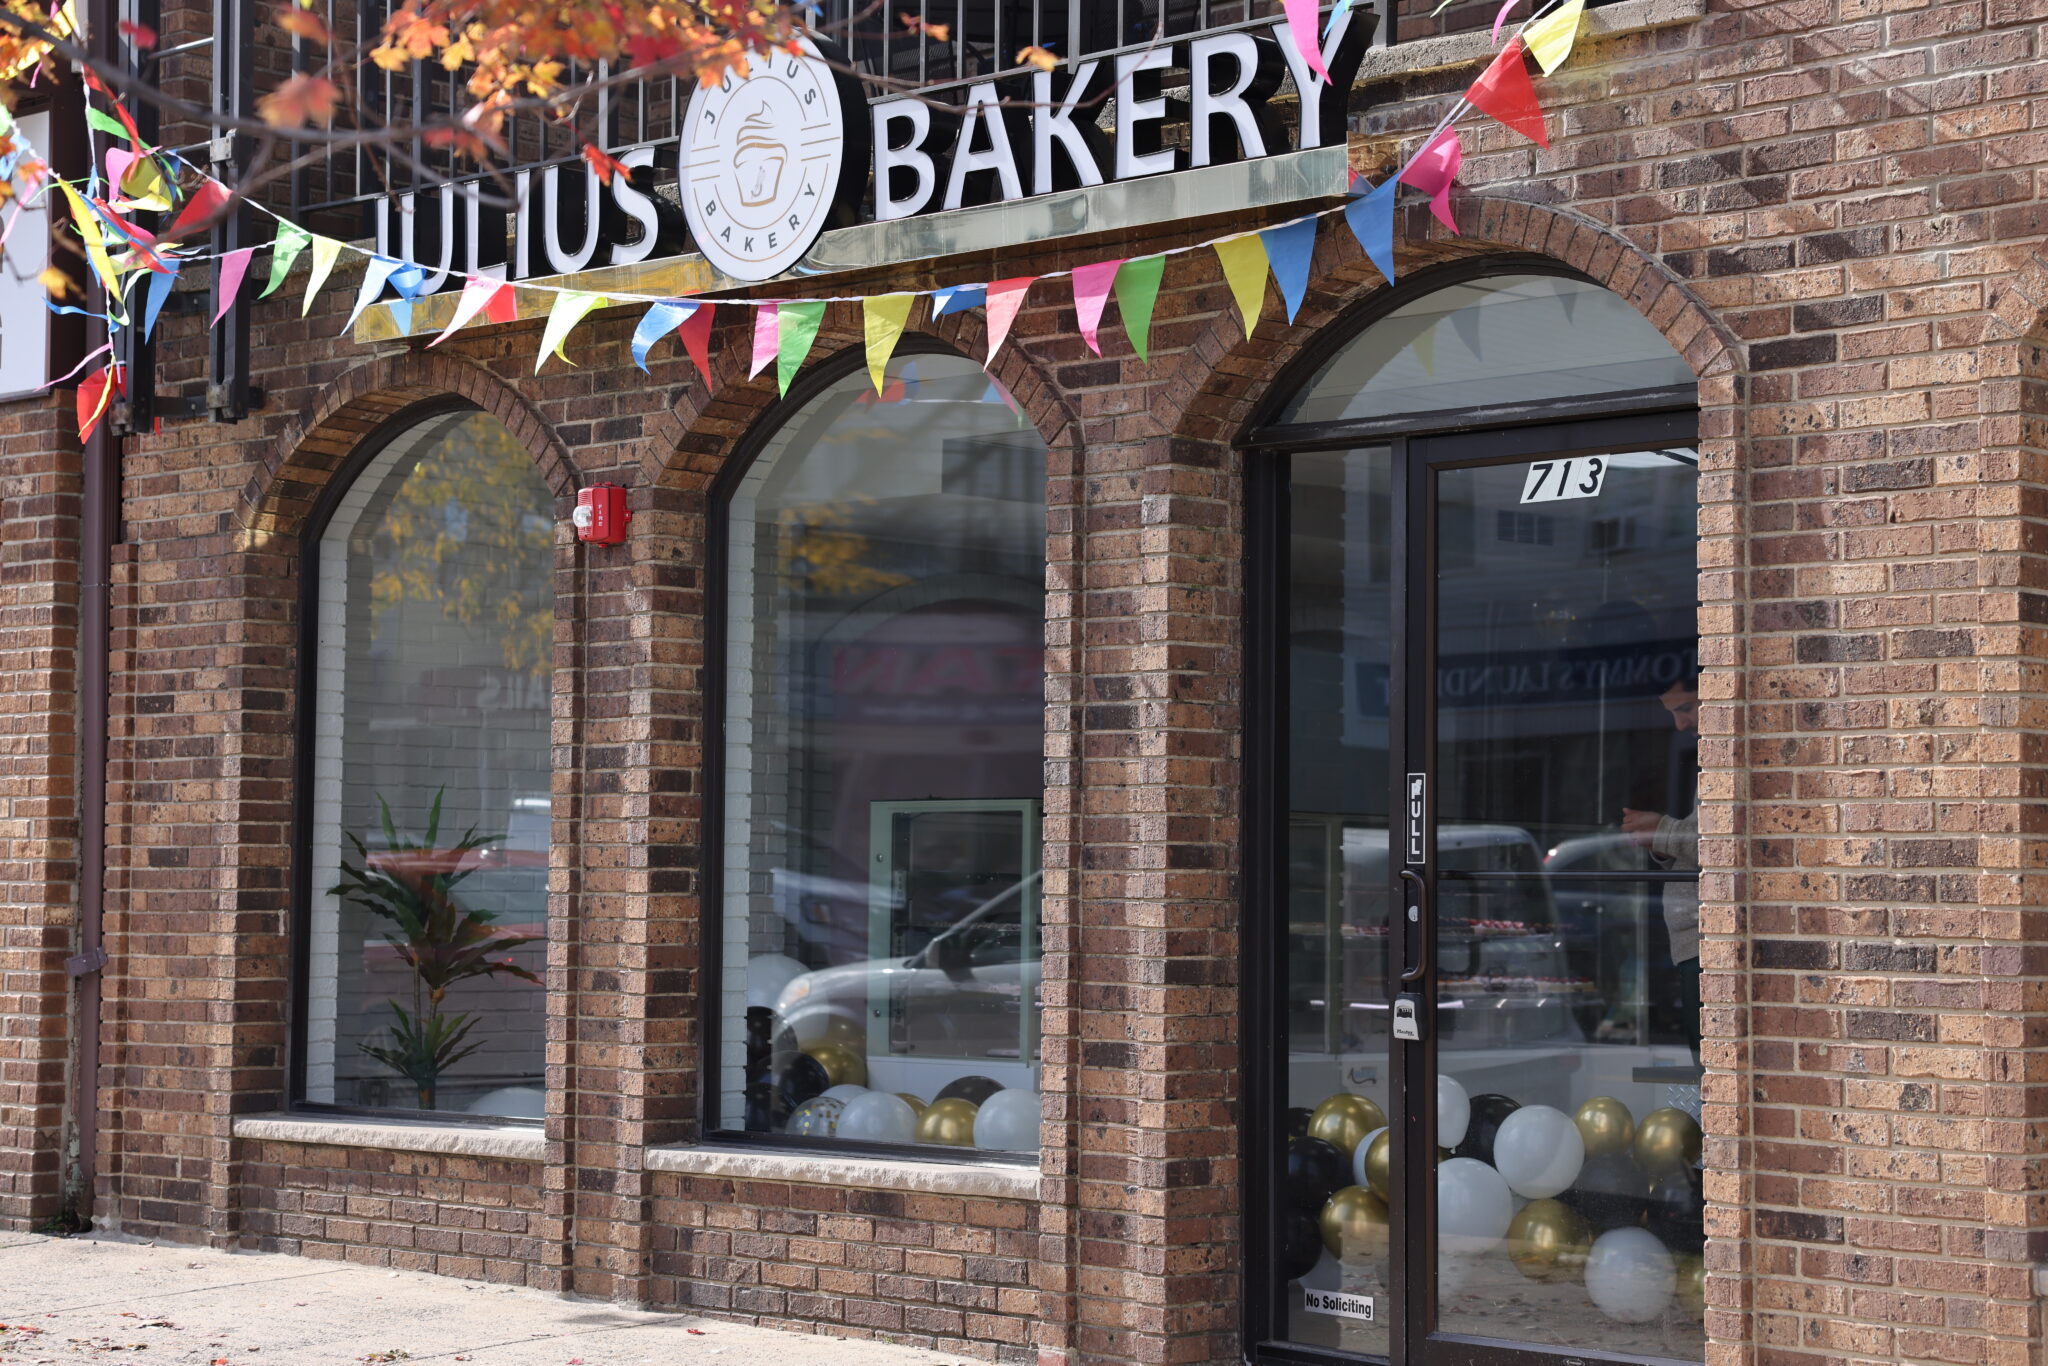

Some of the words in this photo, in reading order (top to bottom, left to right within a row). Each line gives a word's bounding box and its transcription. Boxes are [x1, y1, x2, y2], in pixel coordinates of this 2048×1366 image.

[704, 53, 817, 124] JUIUS
[873, 10, 1353, 222] BAKERY
[705, 183, 815, 252] BAKERY
[1527, 458, 1602, 500] 713
[1306, 1293, 1320, 1308] No
[1322, 1295, 1371, 1318] Soliciting
